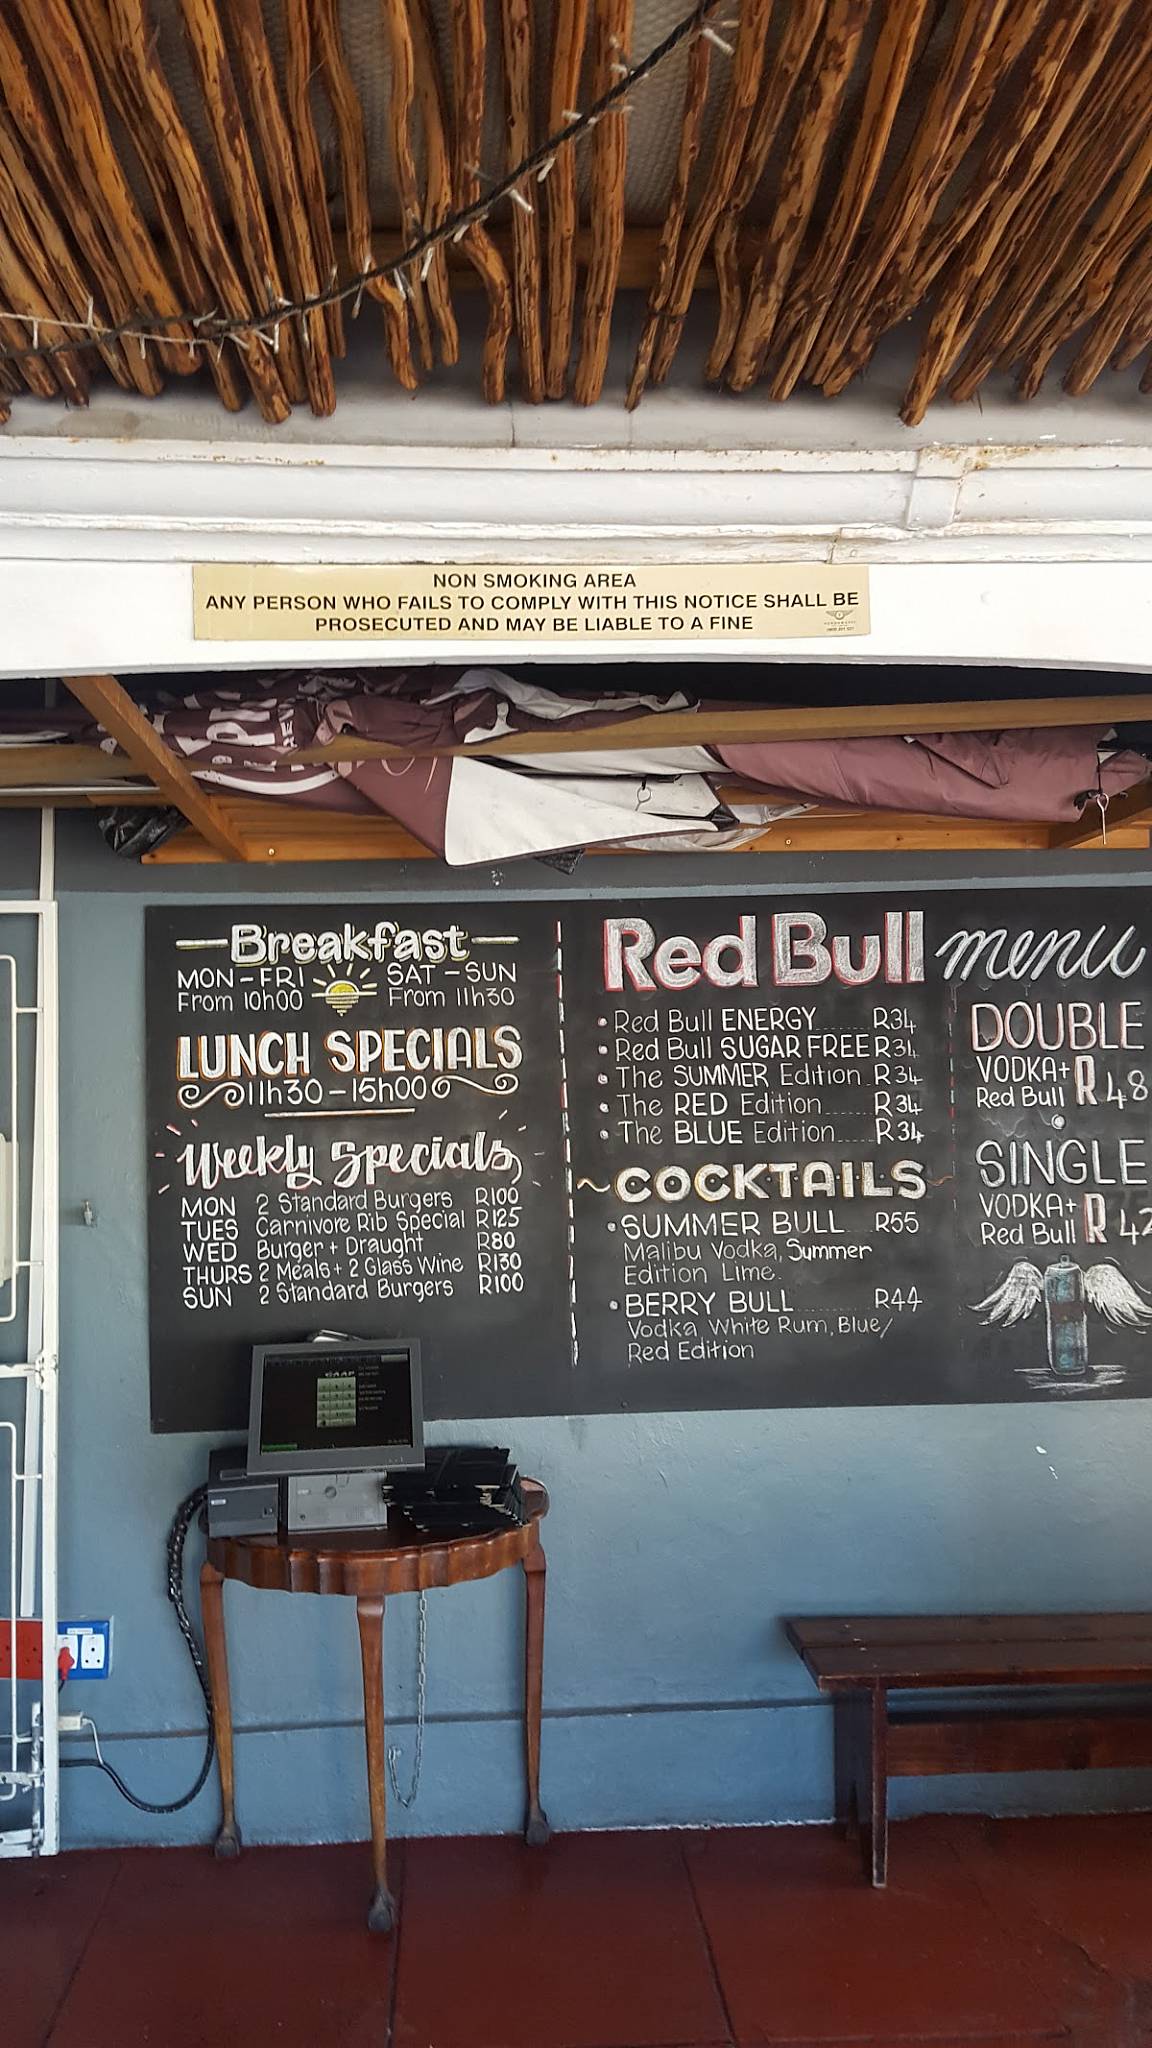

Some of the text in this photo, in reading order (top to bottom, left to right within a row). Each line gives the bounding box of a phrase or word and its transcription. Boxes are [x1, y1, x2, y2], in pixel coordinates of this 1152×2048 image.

[433, 574, 636, 588] NON SMOKING AREA
[206, 592, 859, 610] ANY PERSON WHO FAILS TO COMPLY WITH THIS NOTICE SHALL BE
[316, 616, 753, 632] PROSECUTED AND MAY BE LIABLE TO A FINE
[230, 922, 469, 967] Breakfast
[603, 911, 1147, 992] Red Bull menu
[177, 968, 234, 989] MON
[260, 966, 304, 987] FRI
[387, 965, 436, 985] SAT
[465, 962, 517, 983] SUN
[178, 989, 303, 1012] From 10h00
[389, 986, 515, 1008] From 11h30
[614, 1006, 916, 1035] Red Bull ENERGY R34
[971, 1001, 1145, 1051] DOUBLE
[177, 1025, 523, 1081] LUNCH SPECIALS
[616, 1037, 659, 1061] Red
[668, 1037, 712, 1060] Bull
[721, 1035, 802, 1060] SUGAR
[808, 1033, 870, 1058] FREE
[616, 1065, 663, 1088] The
[673, 1063, 769, 1088] SUMMER
[780, 1063, 861, 1087] Edition
[617, 1094, 663, 1117] The
[675, 1092, 728, 1116] RED
[741, 1092, 822, 1115] Edition
[976, 1086, 1065, 1108] Red Bull
[619, 1121, 663, 1146] The
[675, 1120, 743, 1144] BLUE
[754, 1120, 835, 1144] Edition
[177, 1131, 523, 1190] Weekly Specials
[976, 1140, 1148, 1187] SINGLE
[615, 1160, 927, 1203] COCKTAILS
[181, 1187, 519, 1218] MON 2 Standard Burgers R100
[181, 1206, 523, 1242] TUES Carnivore Rib Special R125
[621, 1209, 919, 1239] SUMMER BULL R55
[980, 1220, 1076, 1245] Red Bull
[183, 1241, 237, 1263] WED
[257, 1239, 323, 1263] Burger
[346, 1235, 423, 1258] Draught
[477, 1231, 515, 1250] R80
[624, 1242, 702, 1262] Malibu
[786, 1238, 872, 1261] Summer
[183, 1264, 252, 1285] THURS
[259, 1263, 269, 1283] 2
[349, 1260, 359, 1277] 2
[365, 1256, 412, 1275] Glass
[416, 1254, 464, 1274] Wine
[477, 1252, 522, 1272] R130
[624, 1263, 707, 1286] Edition
[183, 1273, 524, 1309] SUN 2 Standard Burgers R100
[625, 1286, 923, 1318] BERRY BULL R44
[628, 1319, 698, 1339] Vodka
[708, 1317, 770, 1337] White
[628, 1340, 754, 1364] Red Edition
